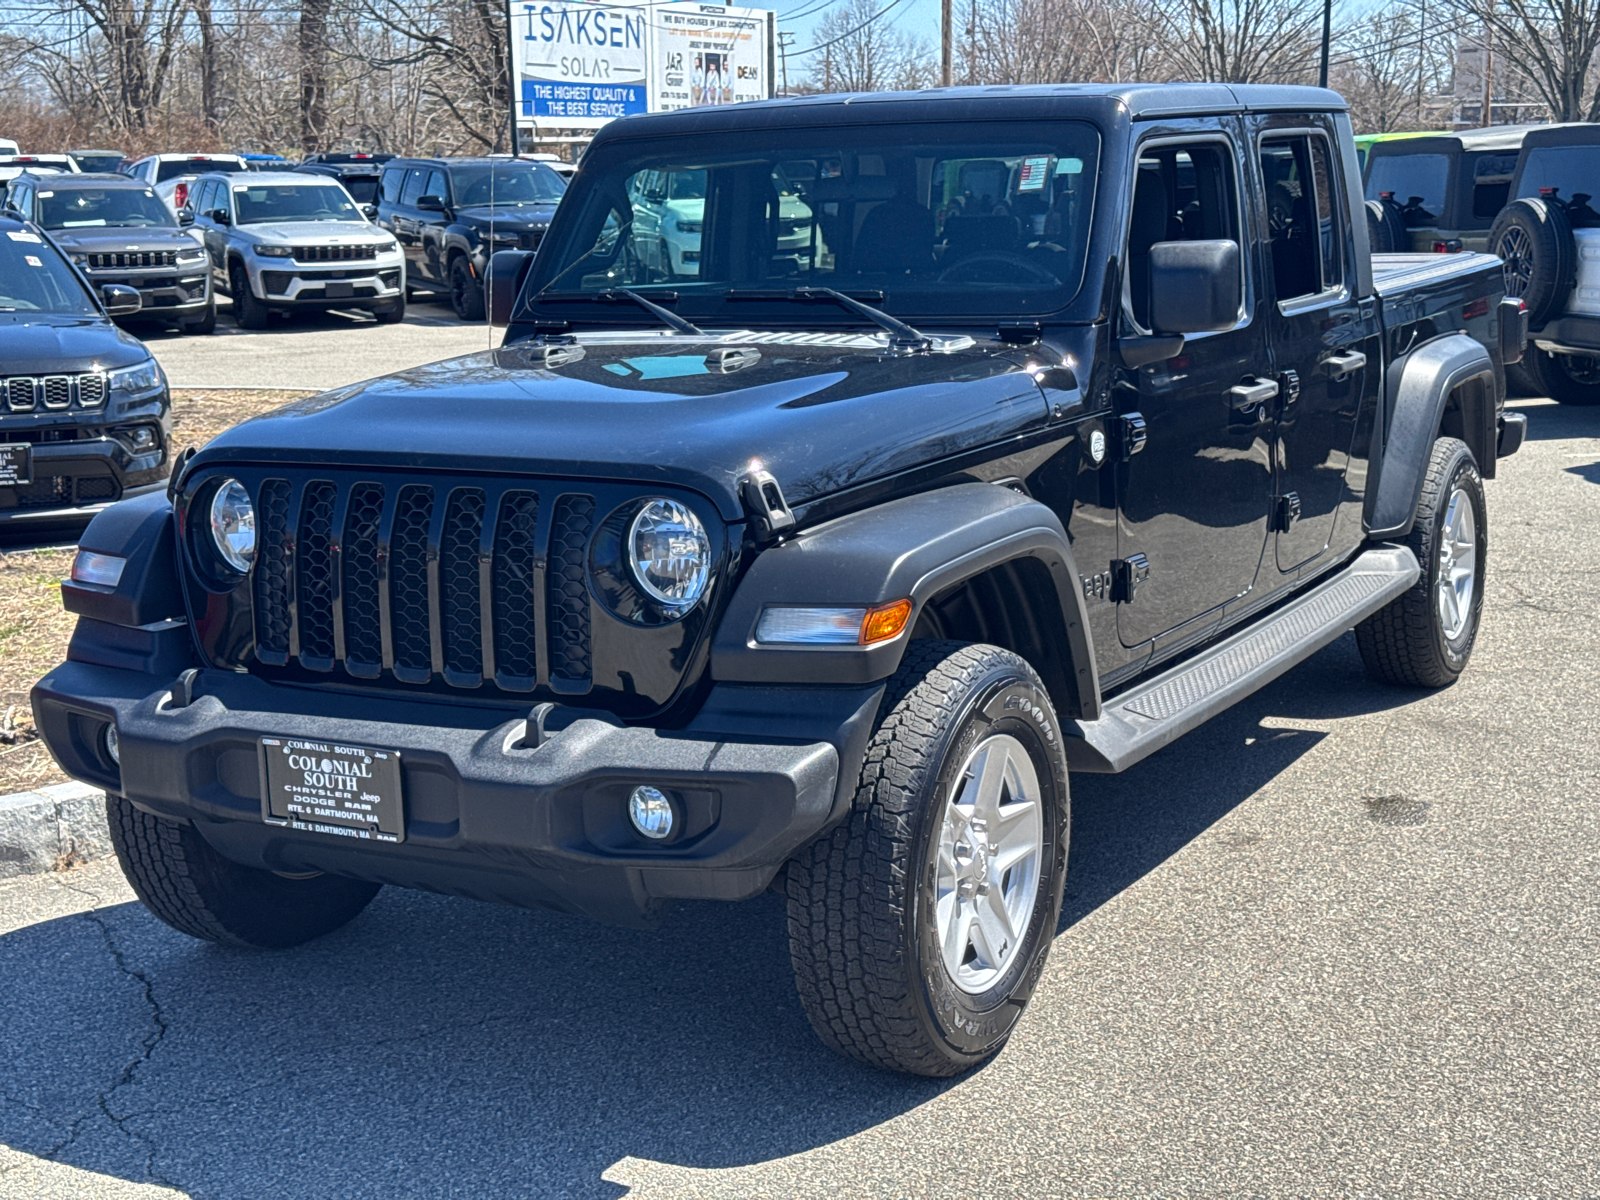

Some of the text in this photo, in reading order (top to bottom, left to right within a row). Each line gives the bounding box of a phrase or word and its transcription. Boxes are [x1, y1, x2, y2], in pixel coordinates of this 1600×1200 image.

[523, 5, 641, 49] ISAKSEN
[663, 15, 673, 24] WE
[674, 16, 686, 25] BUY
[687, 18, 709, 27] HOUSES
[710, 19, 716, 27] IN
[560, 56, 611, 78] SOLAR
[665, 52, 684, 72] JAR
[533, 84, 636, 102] THE HIGHEST QUALITY &
[546, 101, 626, 117] THE BEST SERVICE
[1079, 571, 1112, 600] eep
[288, 740, 331, 753] COLONIAL
[334, 746, 366, 757] SOUTH
[288, 754, 372, 778] COLONIAL
[303, 771, 358, 792] SOUTH
[284, 784, 381, 804] CHRYSLER Jeep
[293, 794, 372, 811] DODGE RAM
[287, 803, 379, 823] RTE. 6 DARTMOUTH, MA
[292, 821, 371, 840] RTE. 6 DARTMOUTH, MA
[376, 834, 398, 843] RAM
